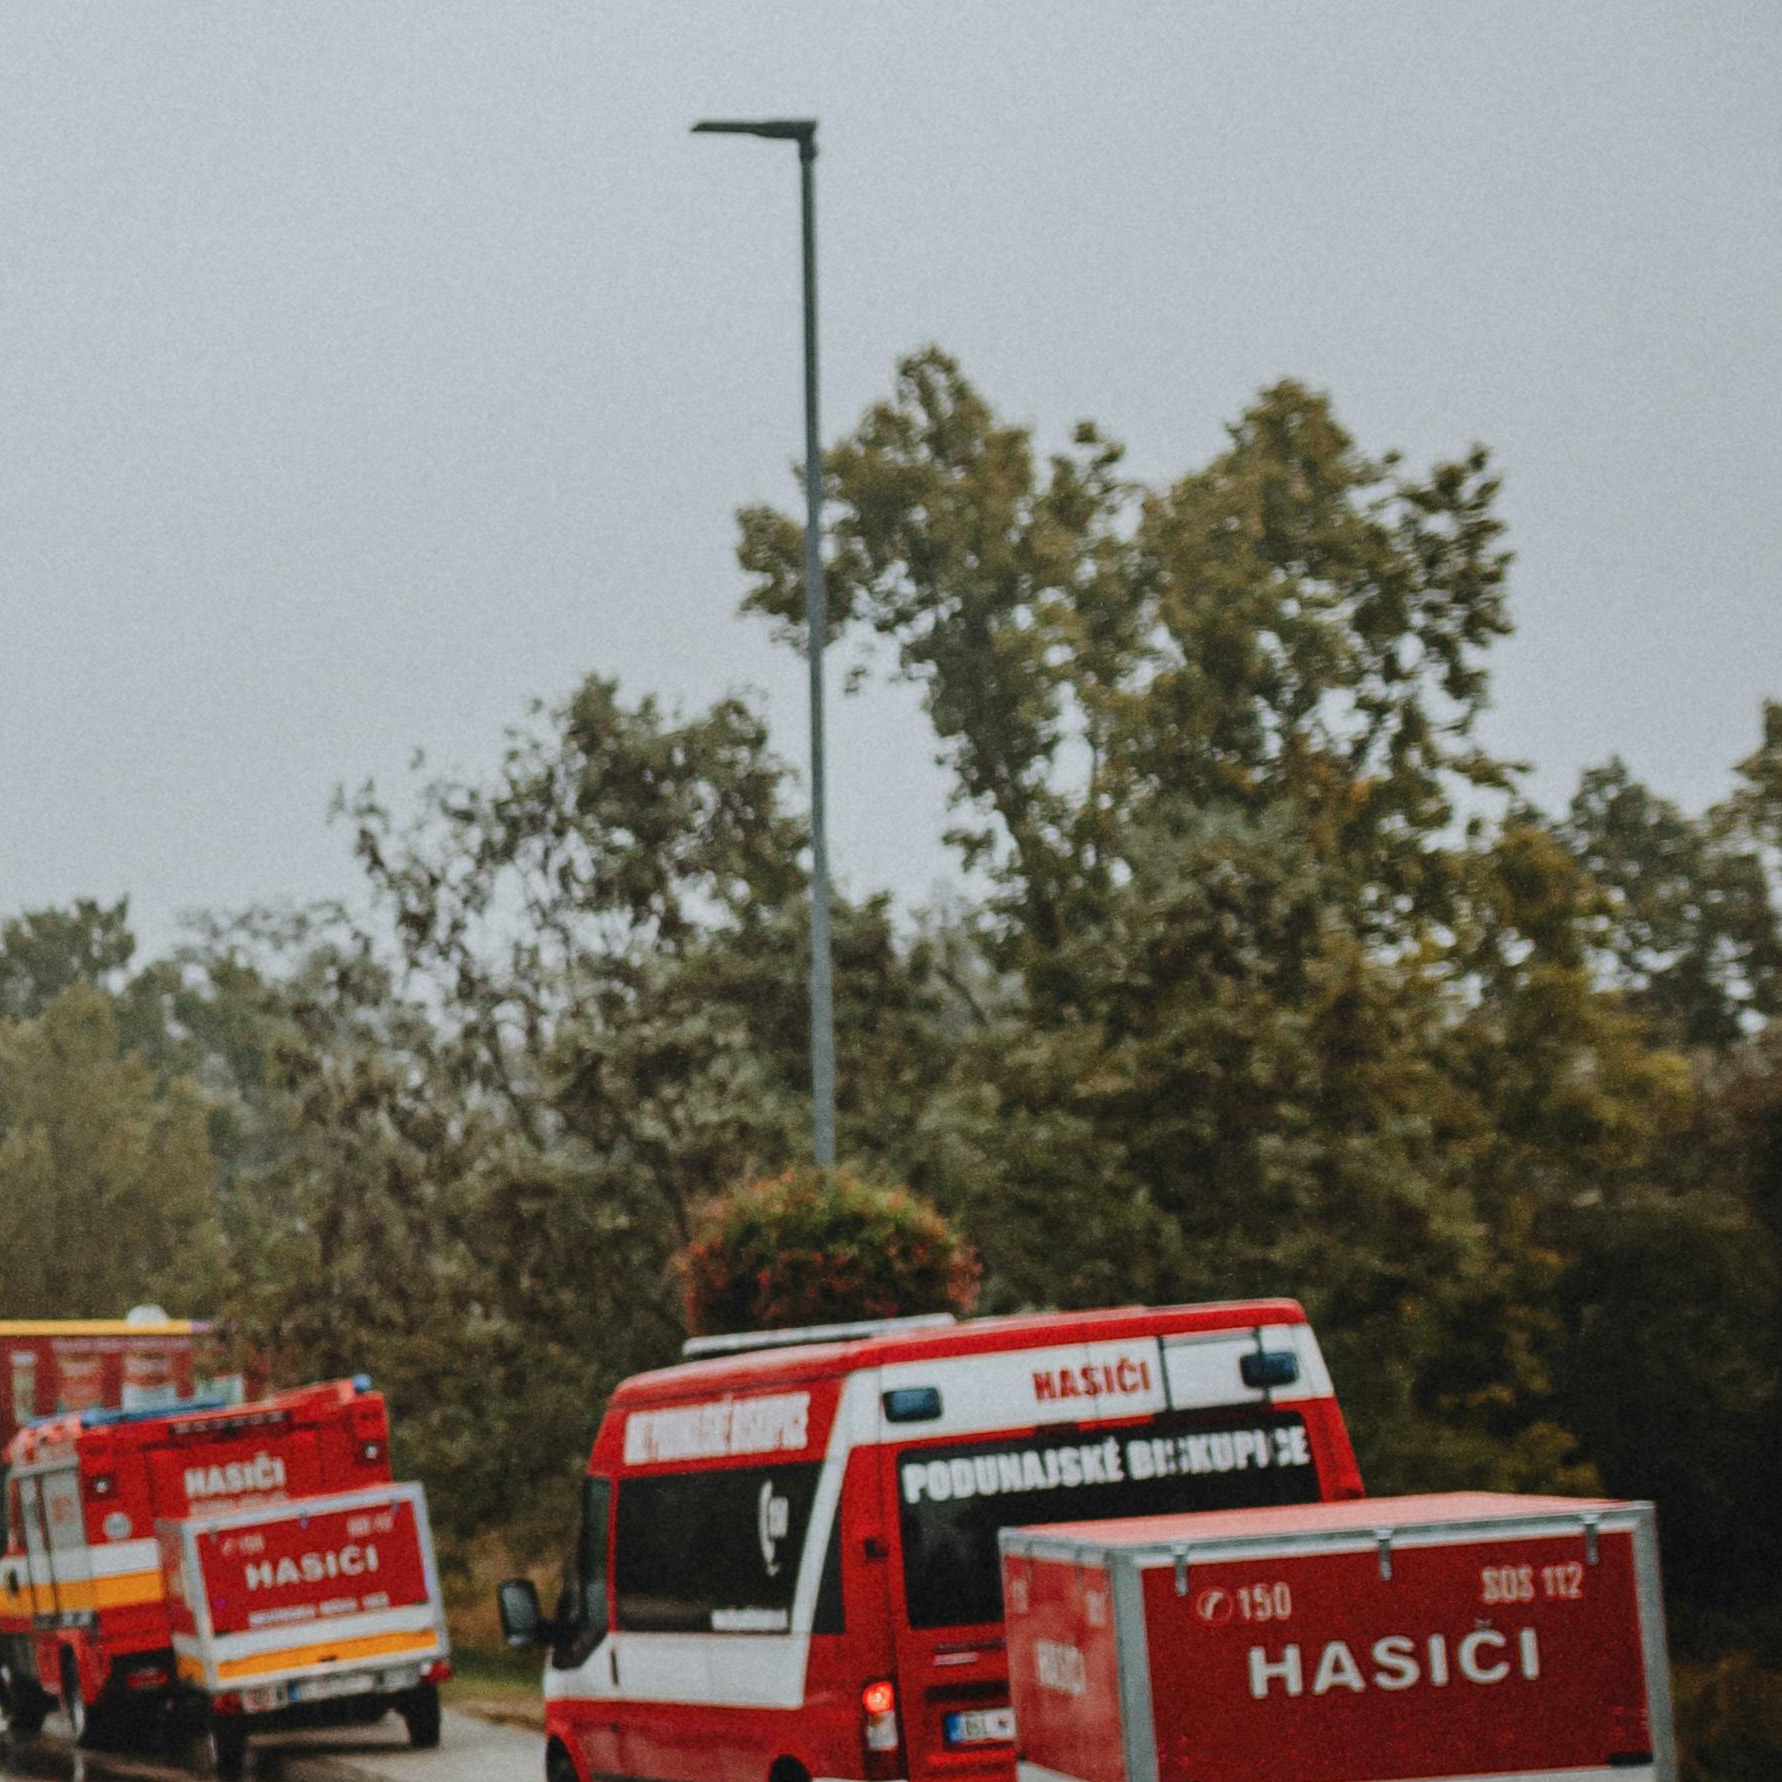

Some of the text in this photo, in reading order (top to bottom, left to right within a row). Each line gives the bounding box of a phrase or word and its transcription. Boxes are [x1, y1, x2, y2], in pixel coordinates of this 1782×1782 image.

[1032, 1358, 1151, 1403] HASIČI
[184, 1451, 285, 1498] HASIČI
[902, 1436, 1125, 1504] PODUNAJSKÉ
[1237, 1581, 1292, 1621] 150
[1482, 1561, 1583, 1604] SOS 112
[1248, 1618, 1540, 1698] HASIČI
